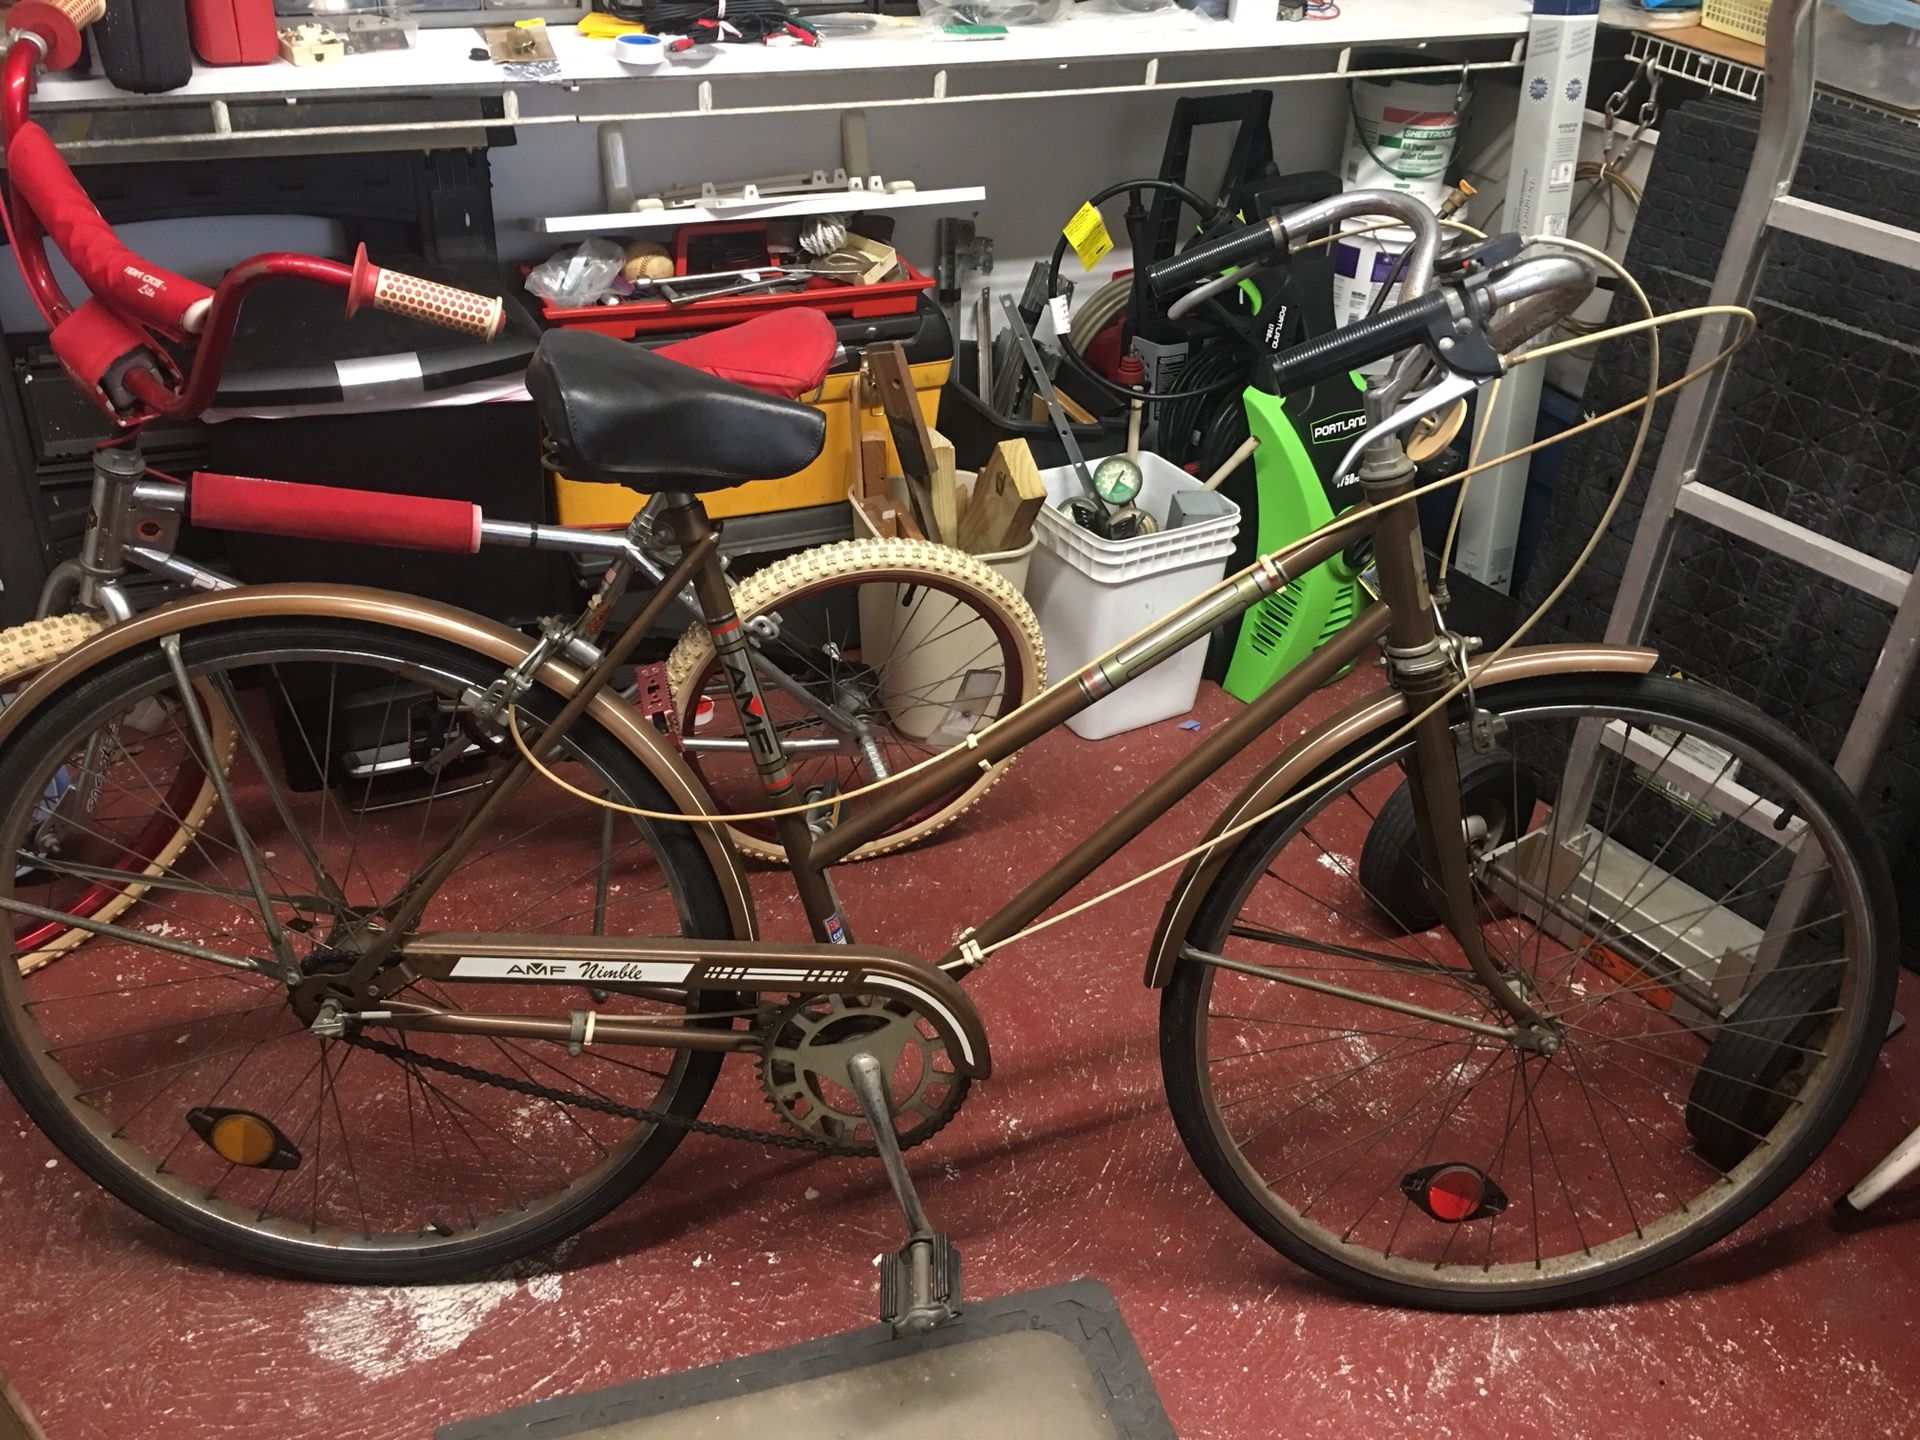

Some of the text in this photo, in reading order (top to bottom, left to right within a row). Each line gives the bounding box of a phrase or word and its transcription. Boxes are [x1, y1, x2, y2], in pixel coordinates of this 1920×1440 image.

[1271, 305, 1287, 349] PORTLAND
[1314, 414, 1367, 439] PORTLAND
[724, 662, 775, 755] AMF
[506, 961, 642, 980] AMF Nimble
